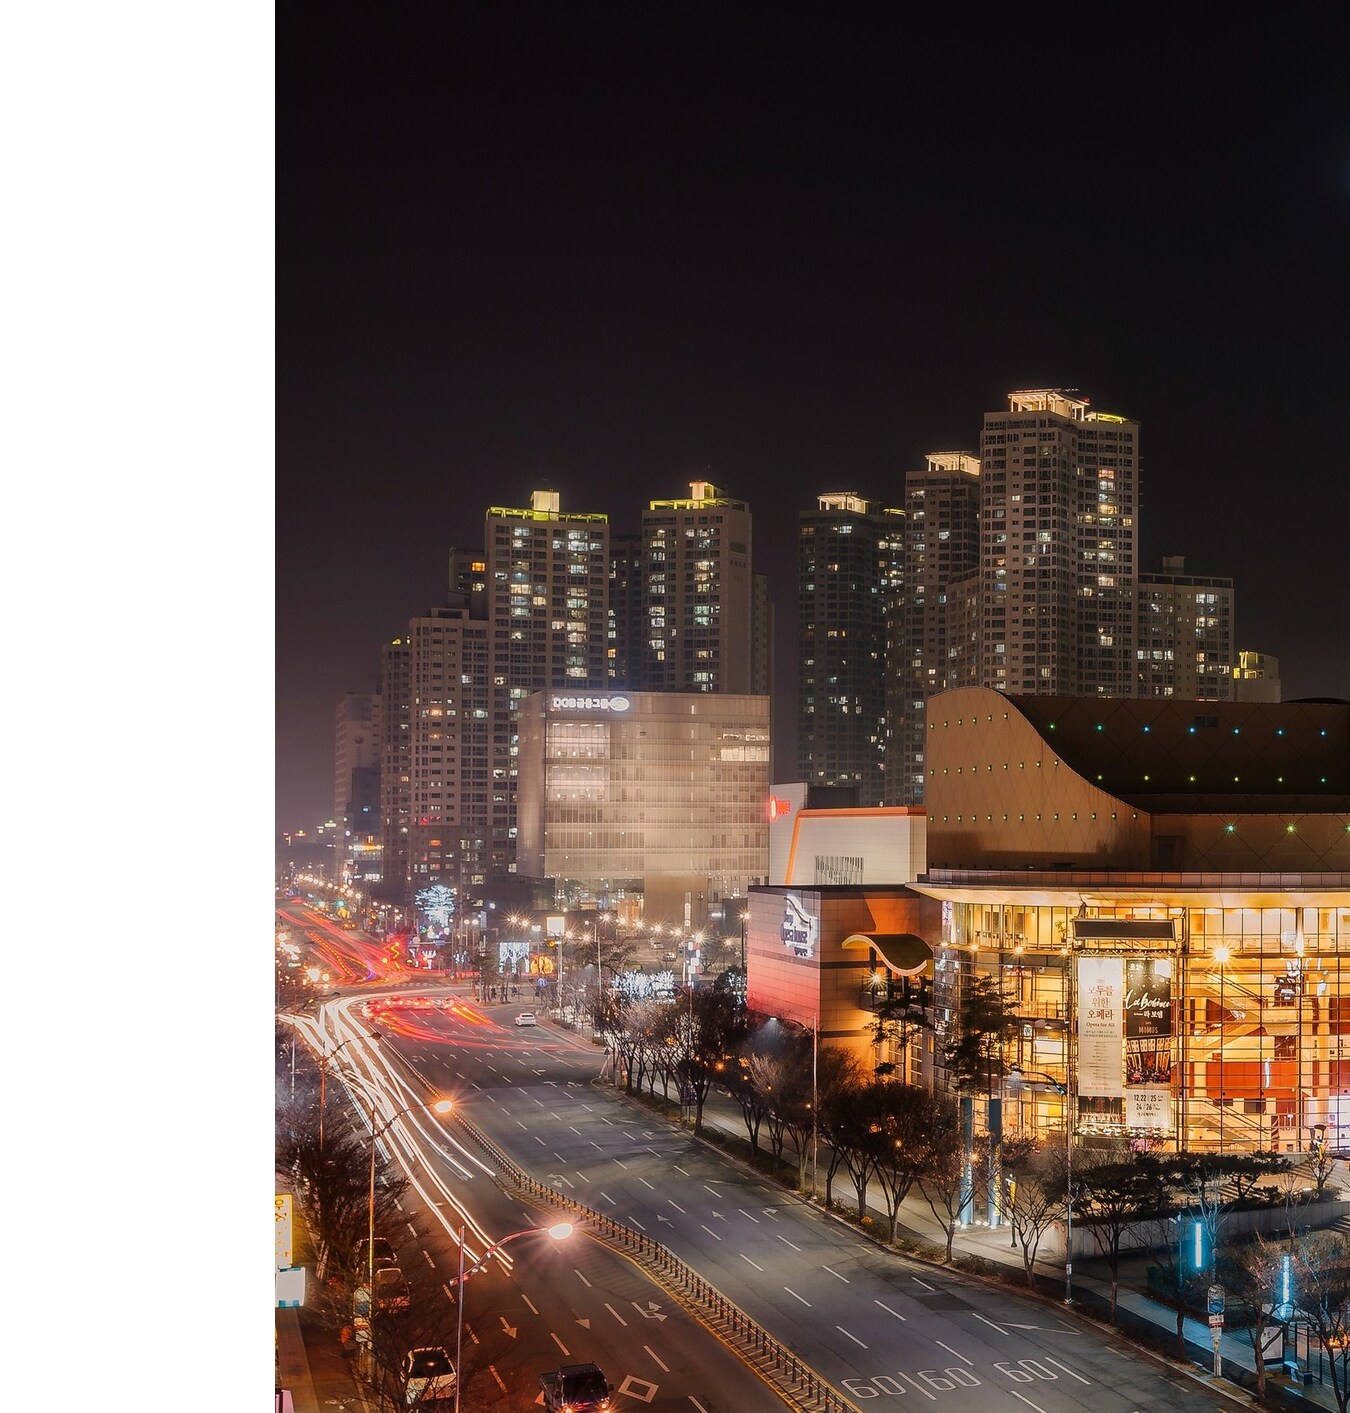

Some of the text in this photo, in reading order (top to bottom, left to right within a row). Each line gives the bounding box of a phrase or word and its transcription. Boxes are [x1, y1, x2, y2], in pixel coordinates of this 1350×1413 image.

[1091, 997, 1110, 1008] 위한
[1087, 1009, 1115, 1021] 오페라
[917, 1367, 982, 1391] 60
[993, 1359, 1059, 1382] 60
[840, 1375, 907, 1399] 60
